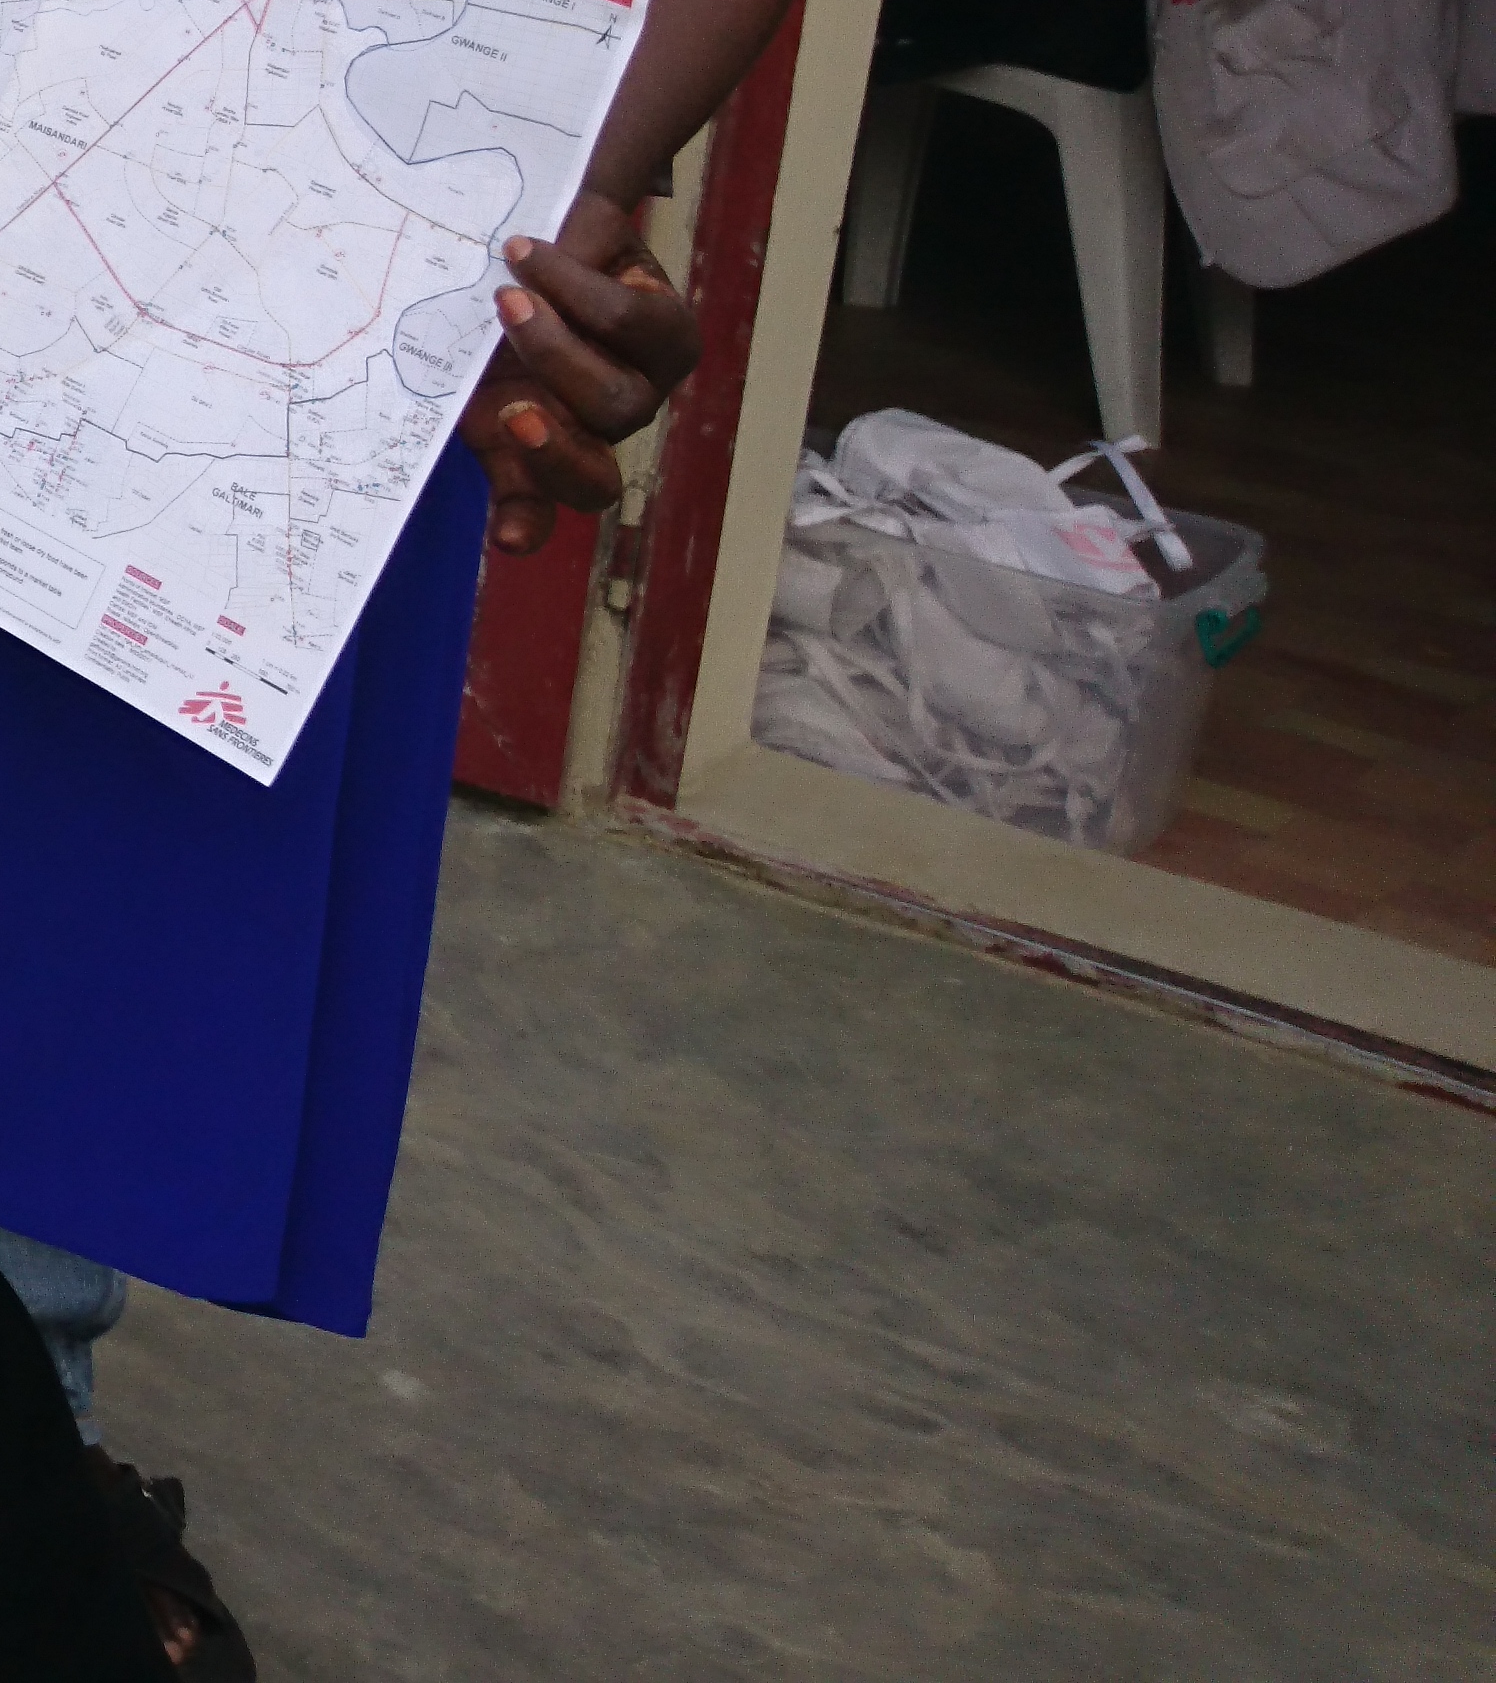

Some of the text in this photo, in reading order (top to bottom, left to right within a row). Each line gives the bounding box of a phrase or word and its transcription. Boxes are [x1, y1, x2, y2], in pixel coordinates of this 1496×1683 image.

[451, 34, 499, 59] GWANGE
[27, 120, 89, 150] MAISANDARI
[398, 342, 444, 368] GWANGE
[212, 487, 264, 518] GALTIMARI
[230, 481, 257, 502] BALE
[206, 724, 274, 767] SANS FRONTIERES
[218, 719, 260, 746] MEDECINS
